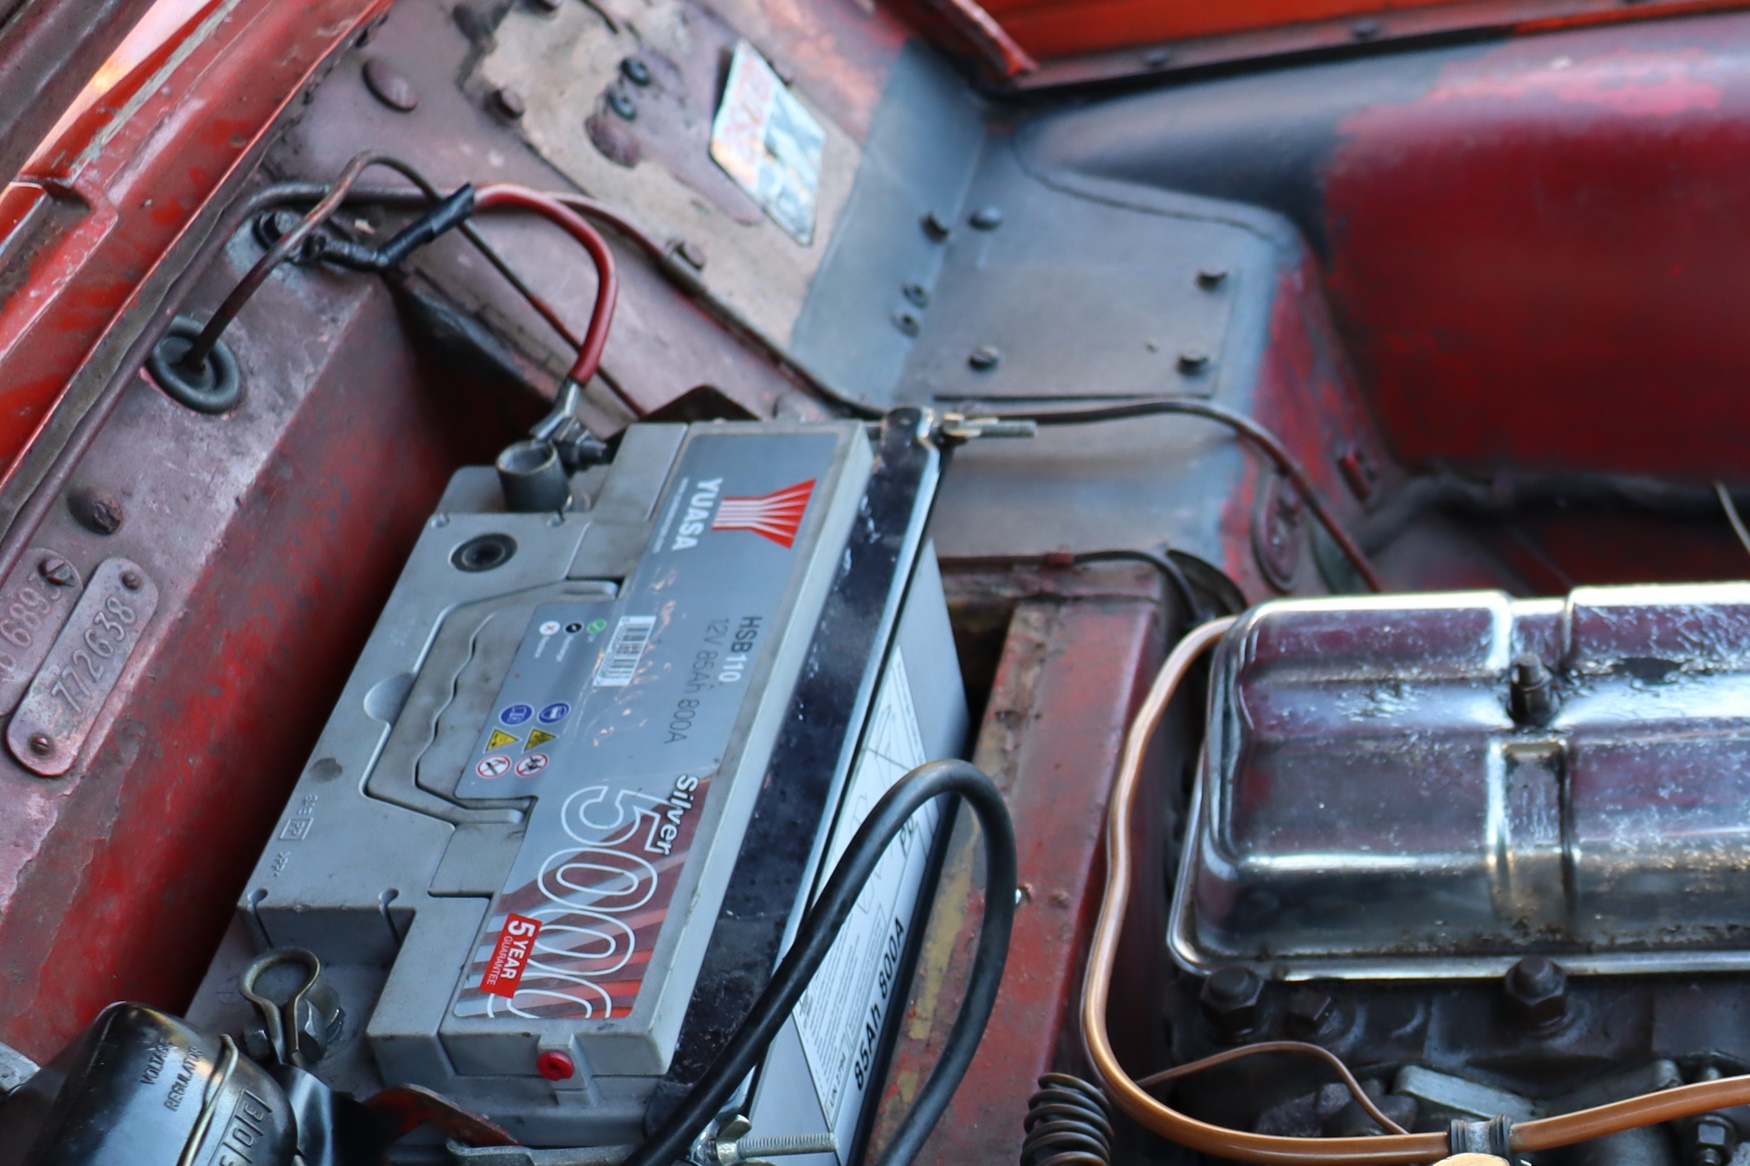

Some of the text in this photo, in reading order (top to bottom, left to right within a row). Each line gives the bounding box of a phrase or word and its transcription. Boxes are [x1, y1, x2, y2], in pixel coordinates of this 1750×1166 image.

[671, 477, 723, 551] YUASA
[51, 597, 135, 713] 772638
[664, 618, 729, 744] 12V 85Ah 800A
[655, 774, 698, 856] Silver
[487, 785, 669, 1018] 5000
[486, 936, 513, 986] GUARANTEE
[500, 919, 535, 980] 5 YEAR
[854, 1002, 882, 1091] 85Ah
[878, 916, 904, 1000] 800A
[140, 1039, 173, 1085] VOLTAGE
[164, 1045, 204, 1112] REGULATOR
[244, 1102, 264, 1123] E
